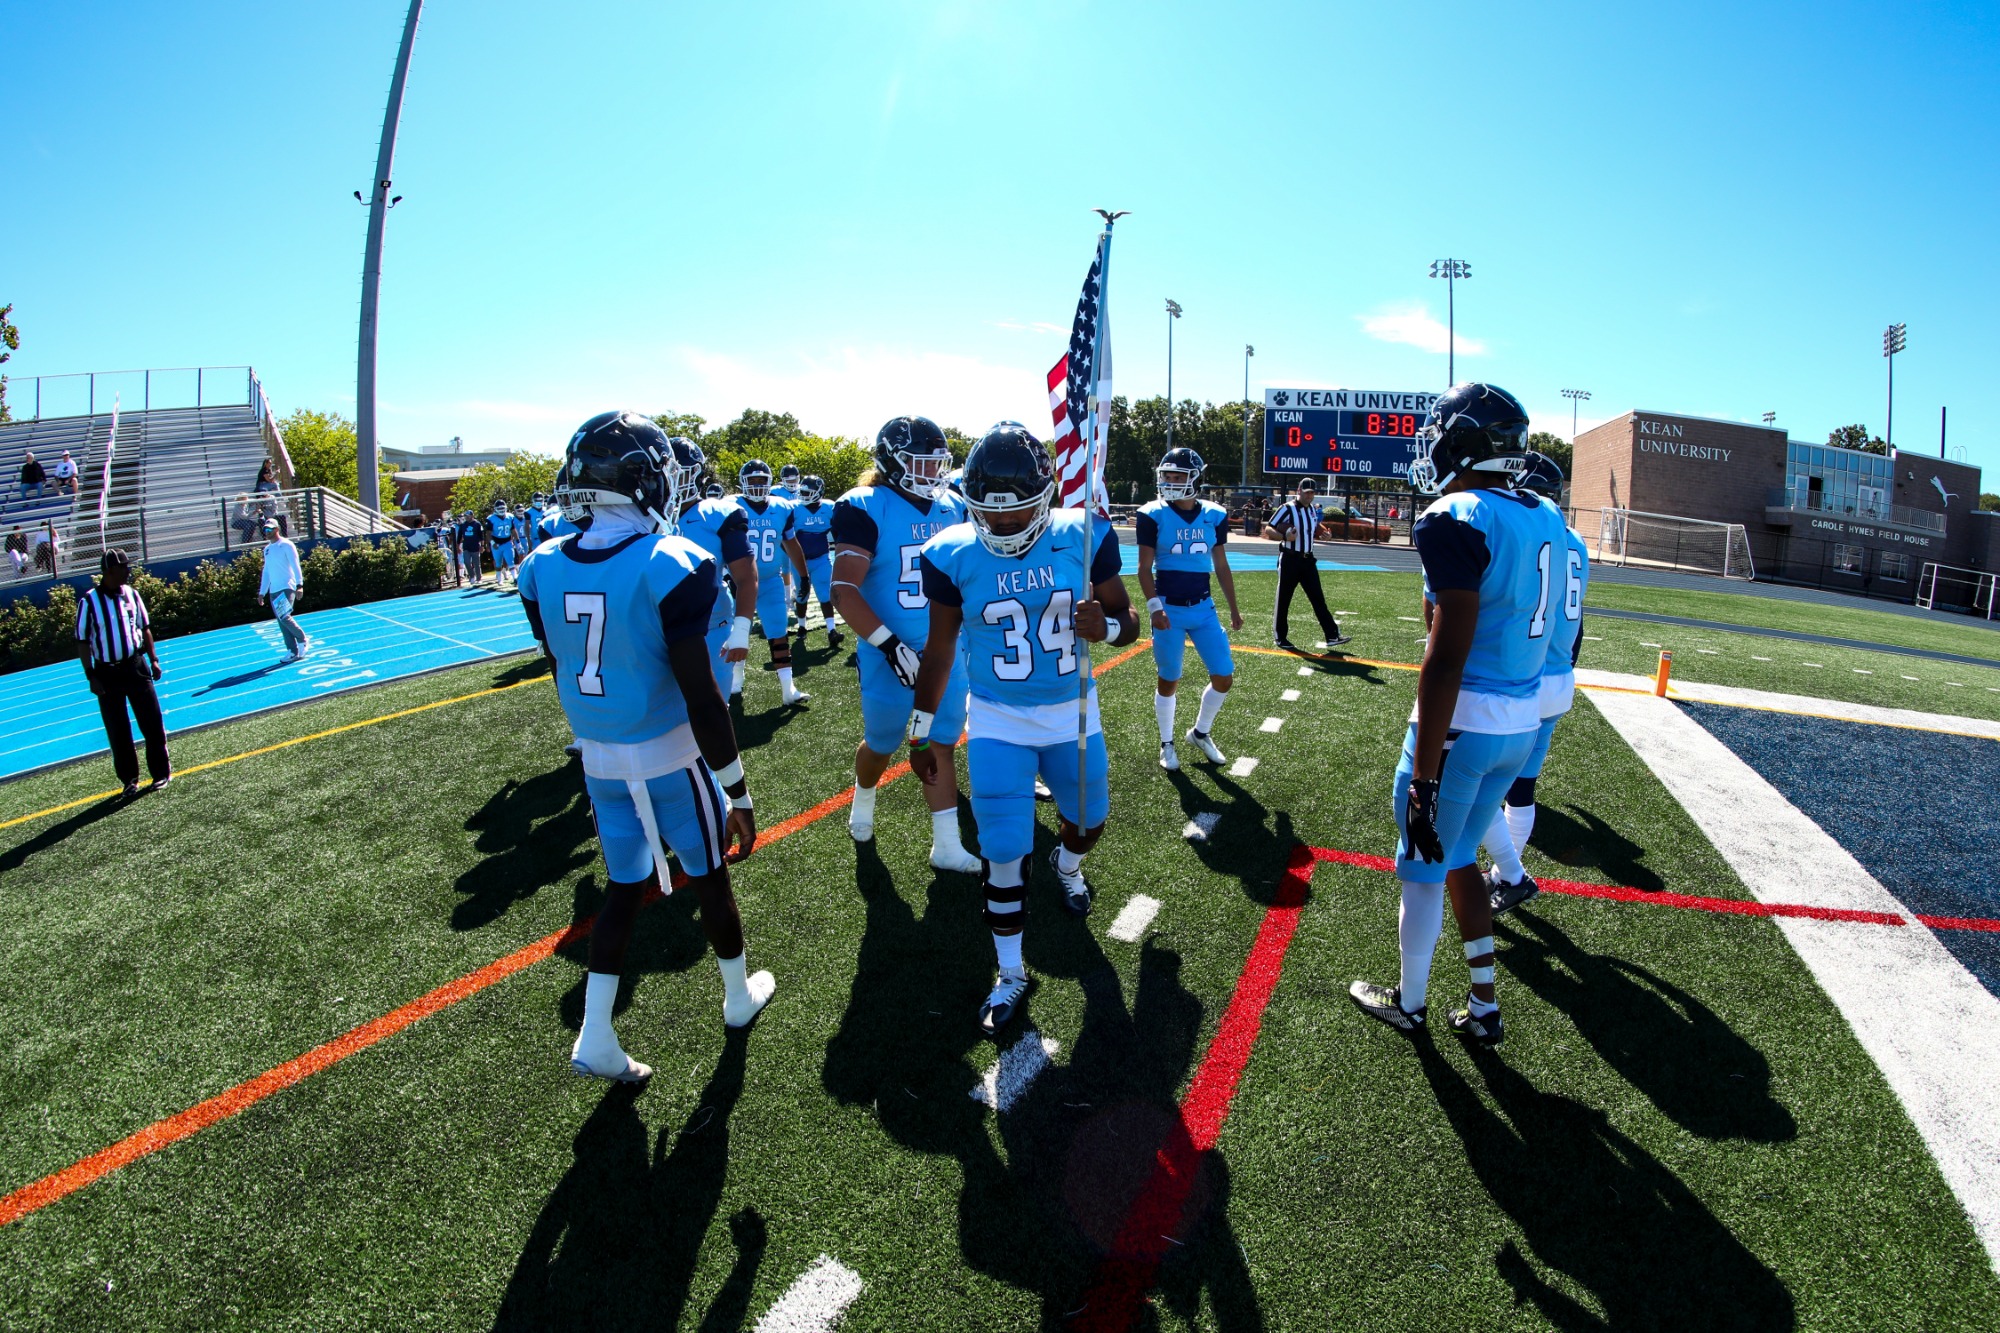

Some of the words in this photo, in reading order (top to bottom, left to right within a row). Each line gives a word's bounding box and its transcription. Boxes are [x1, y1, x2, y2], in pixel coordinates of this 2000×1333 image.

[1296, 391, 1347, 407] KEAN
[1274, 411, 1303, 422] KEAN
[1367, 413, 1415, 436] 8:38
[1288, 426, 1301, 447] 0
[1640, 420, 1683, 437] KEAN
[573, 431, 587, 452] 7
[1329, 438, 1337, 450] 5
[1340, 441, 1359, 450] T.O.L.
[1640, 439, 1732, 461] UNIVERSITY
[1281, 457, 1308, 469] DOWN
[1327, 457, 1342, 472] 10
[1345, 460, 1357, 472] TO
[1359, 461, 1372, 472] GO
[750, 519, 772, 528] KEAN
[911, 522, 944, 540] KEAN
[1176, 528, 1204, 540] KEAN
[1811, 519, 1844, 532] CAROLE
[1848, 525, 1875, 537] HYNES
[1879, 530, 1900, 541] FIELD
[1904, 534, 1929, 547] HOUSE
[996, 565, 1055, 595] KEAN
[1528, 541, 1551, 639] 1
[981, 588, 1077, 681] 34
[563, 591, 607, 697] 7
